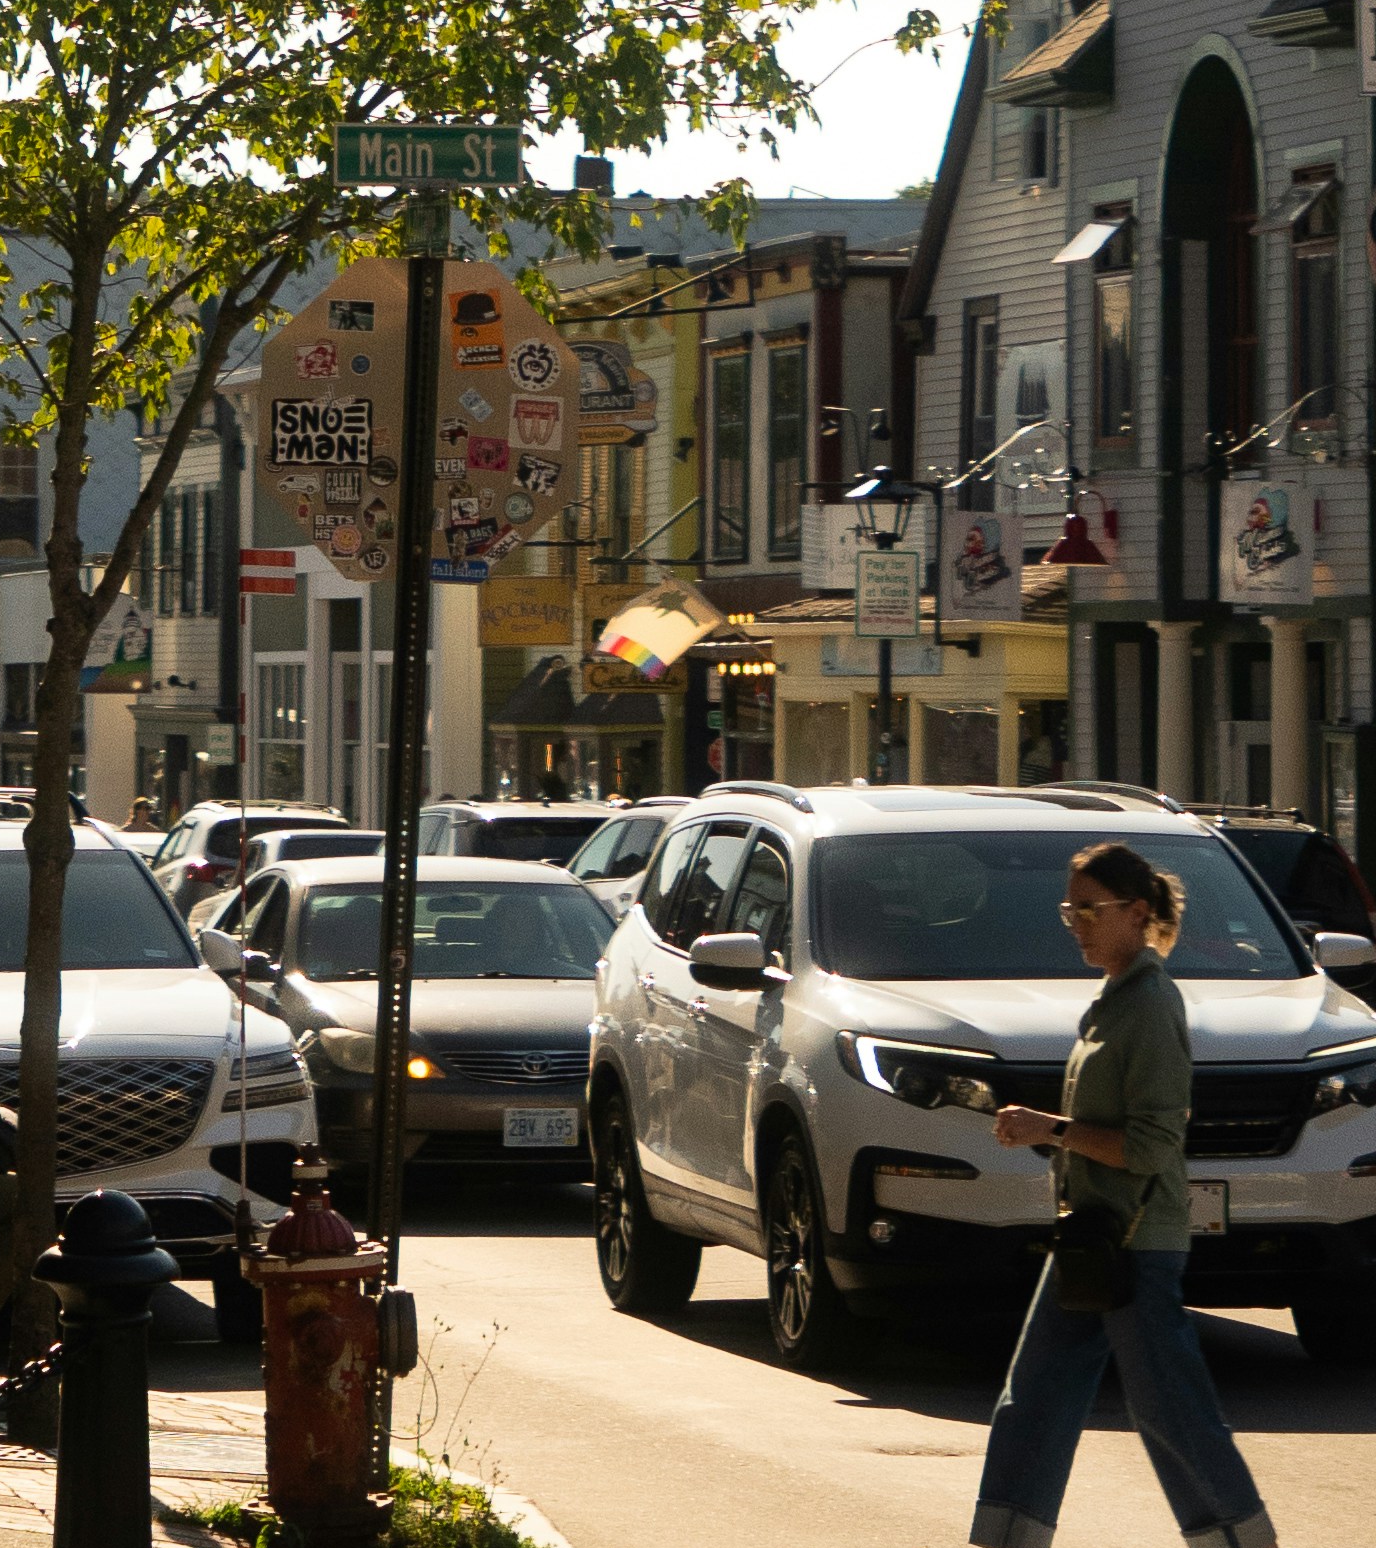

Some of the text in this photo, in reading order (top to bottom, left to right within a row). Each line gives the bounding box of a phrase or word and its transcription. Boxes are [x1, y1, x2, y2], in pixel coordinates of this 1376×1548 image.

[358, 133, 498, 178] Main St
[556, 1118, 583, 1137] 695
